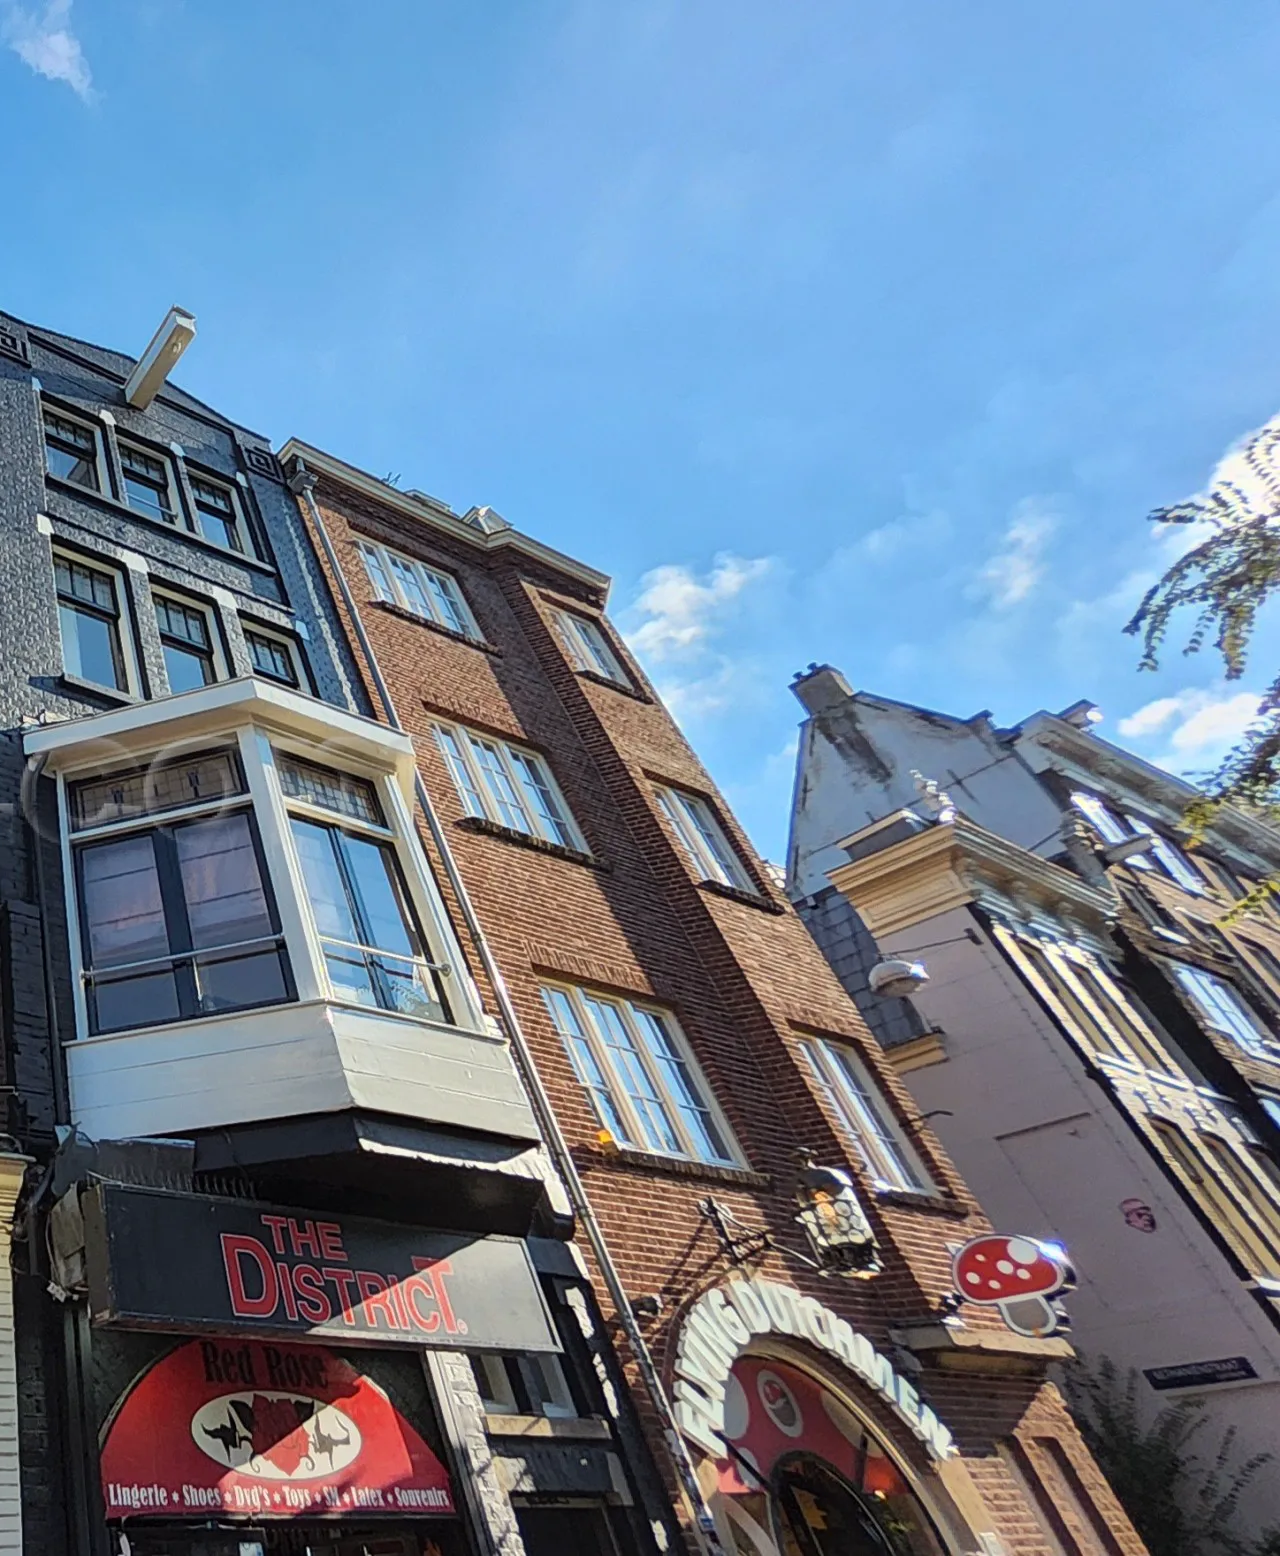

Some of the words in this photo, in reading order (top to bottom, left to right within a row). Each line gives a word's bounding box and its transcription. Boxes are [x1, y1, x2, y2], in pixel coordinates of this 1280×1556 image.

[260, 1214, 348, 1262] THE
[220, 1232, 459, 1335] DISTRICT
[201, 1341, 255, 1384] Red
[263, 1346, 328, 1388] Rose
[672, 1287, 751, 1460] FLYING
[726, 1278, 959, 1461] DUTCHMEN
[108, 1483, 168, 1508] Lingerie
[182, 1484, 222, 1506] Shoes
[282, 1485, 312, 1509] Toys
[322, 1486, 341, 1506] SM
[351, 1486, 386, 1507] Latex
[394, 1487, 450, 1507] Souvenirs
